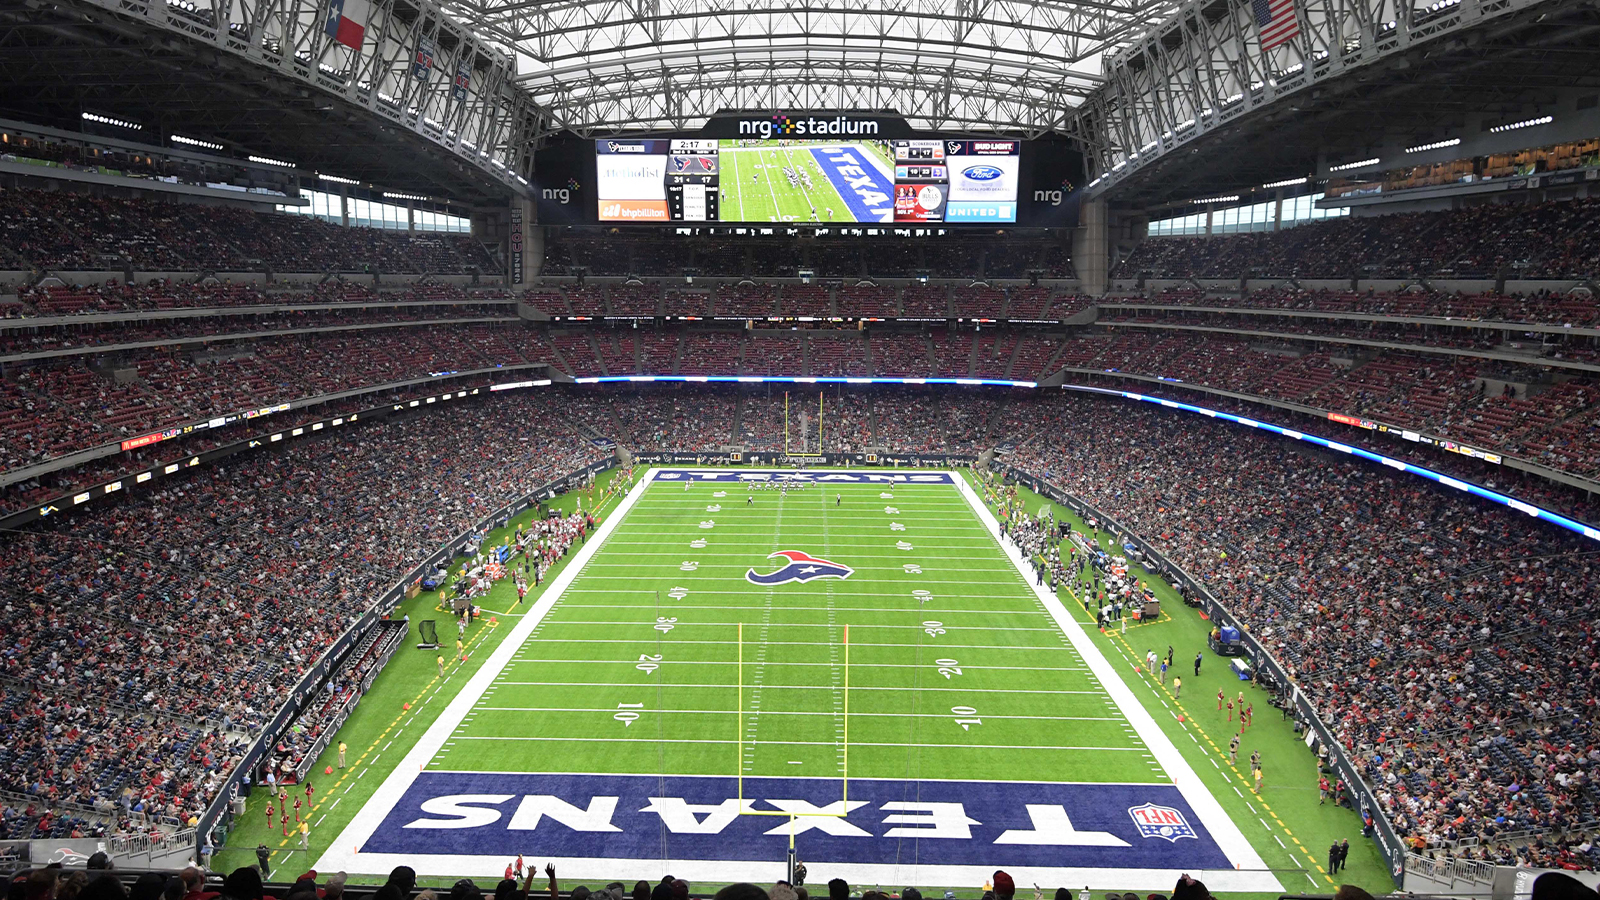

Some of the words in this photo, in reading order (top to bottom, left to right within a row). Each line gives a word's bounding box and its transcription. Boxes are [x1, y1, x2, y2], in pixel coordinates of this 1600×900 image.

[739, 120, 772, 138] nrg
[796, 117, 878, 134] stadium
[603, 167, 659, 178] Methodist
[970, 168, 994, 178] Ford
[542, 189, 570, 204] nrg
[1034, 190, 1062, 206] nrg
[622, 208, 664, 218] bhpbilliton
[512, 224, 522, 252] HOU
[687, 472, 944, 482] TEXANS
[654, 616, 678, 630] 30
[922, 621, 946, 634] 30
[333, 642, 350, 662] TEXANS
[636, 654, 663, 670] 20
[935, 659, 962, 675] 20
[614, 702, 644, 721] 10
[951, 706, 982, 724] 10
[276, 710, 294, 736] TEXANS
[1338, 766, 1359, 800] TEXANS
[402, 794, 1132, 846] TEXANS
[1135, 808, 1181, 824] NFL
